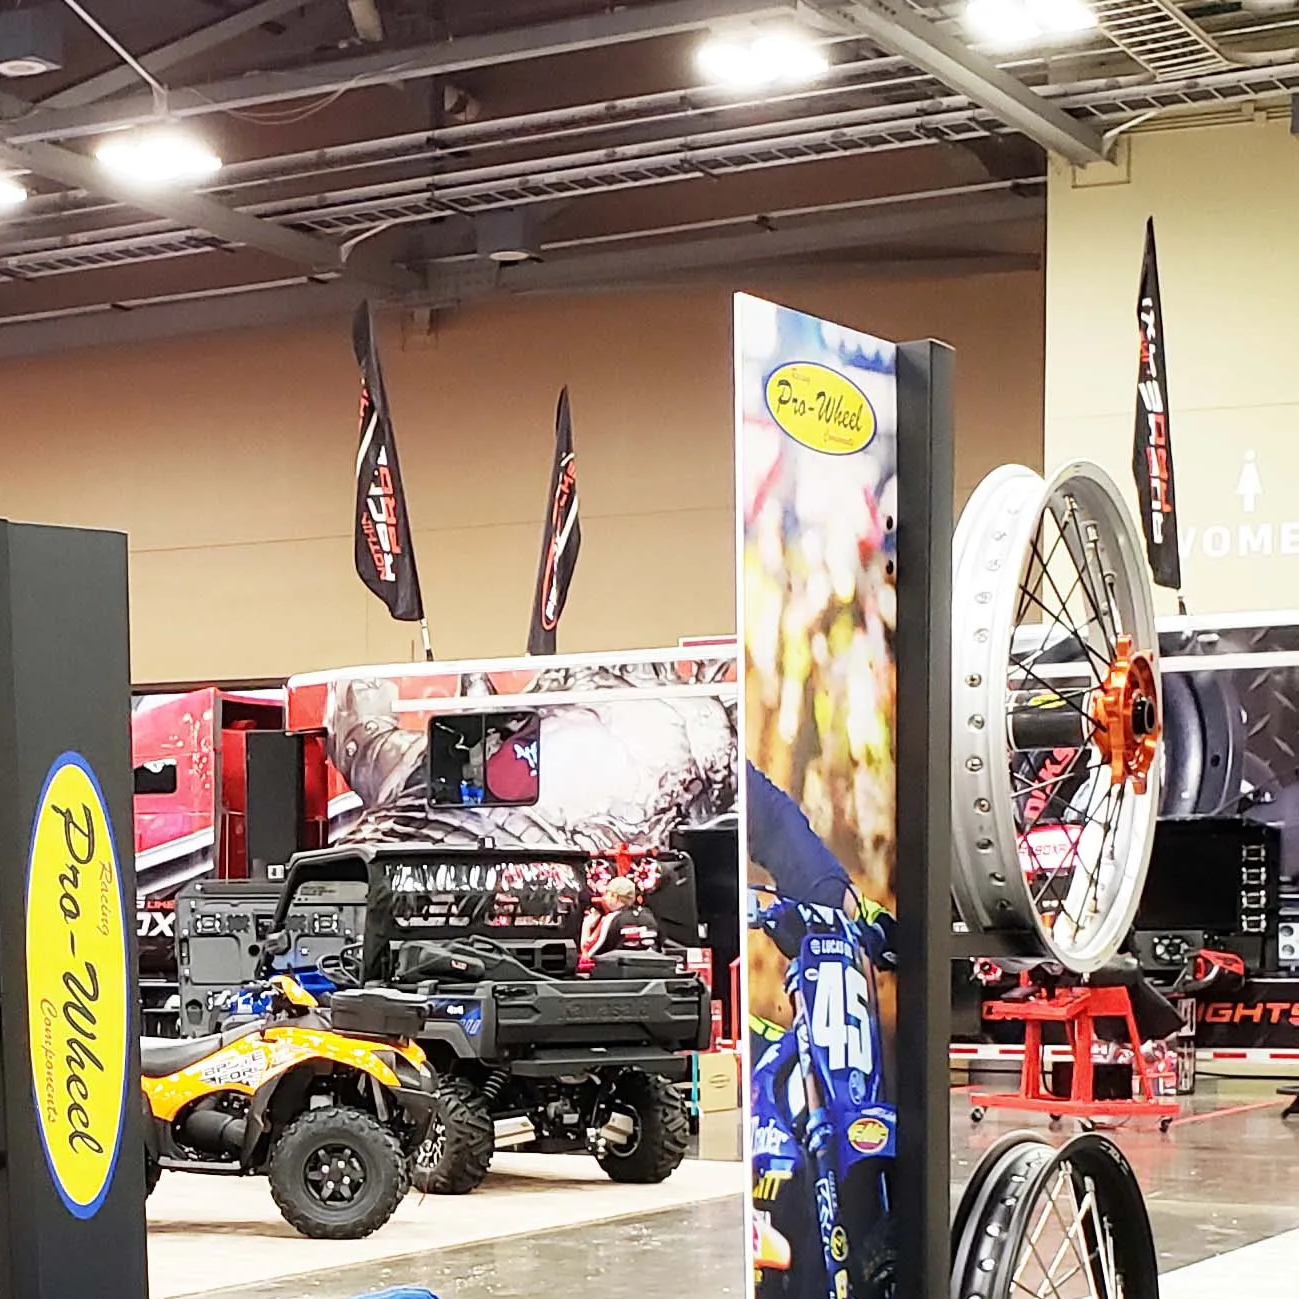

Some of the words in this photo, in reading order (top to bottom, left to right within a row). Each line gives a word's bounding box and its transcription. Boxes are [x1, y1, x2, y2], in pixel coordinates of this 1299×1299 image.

[776, 379, 863, 432] Pro-Wheel
[97, 860, 113, 937] Racing
[51, 802, 104, 1154] Pro-Wheel
[811, 961, 872, 1075] 45
[40, 997, 57, 1124] Components
